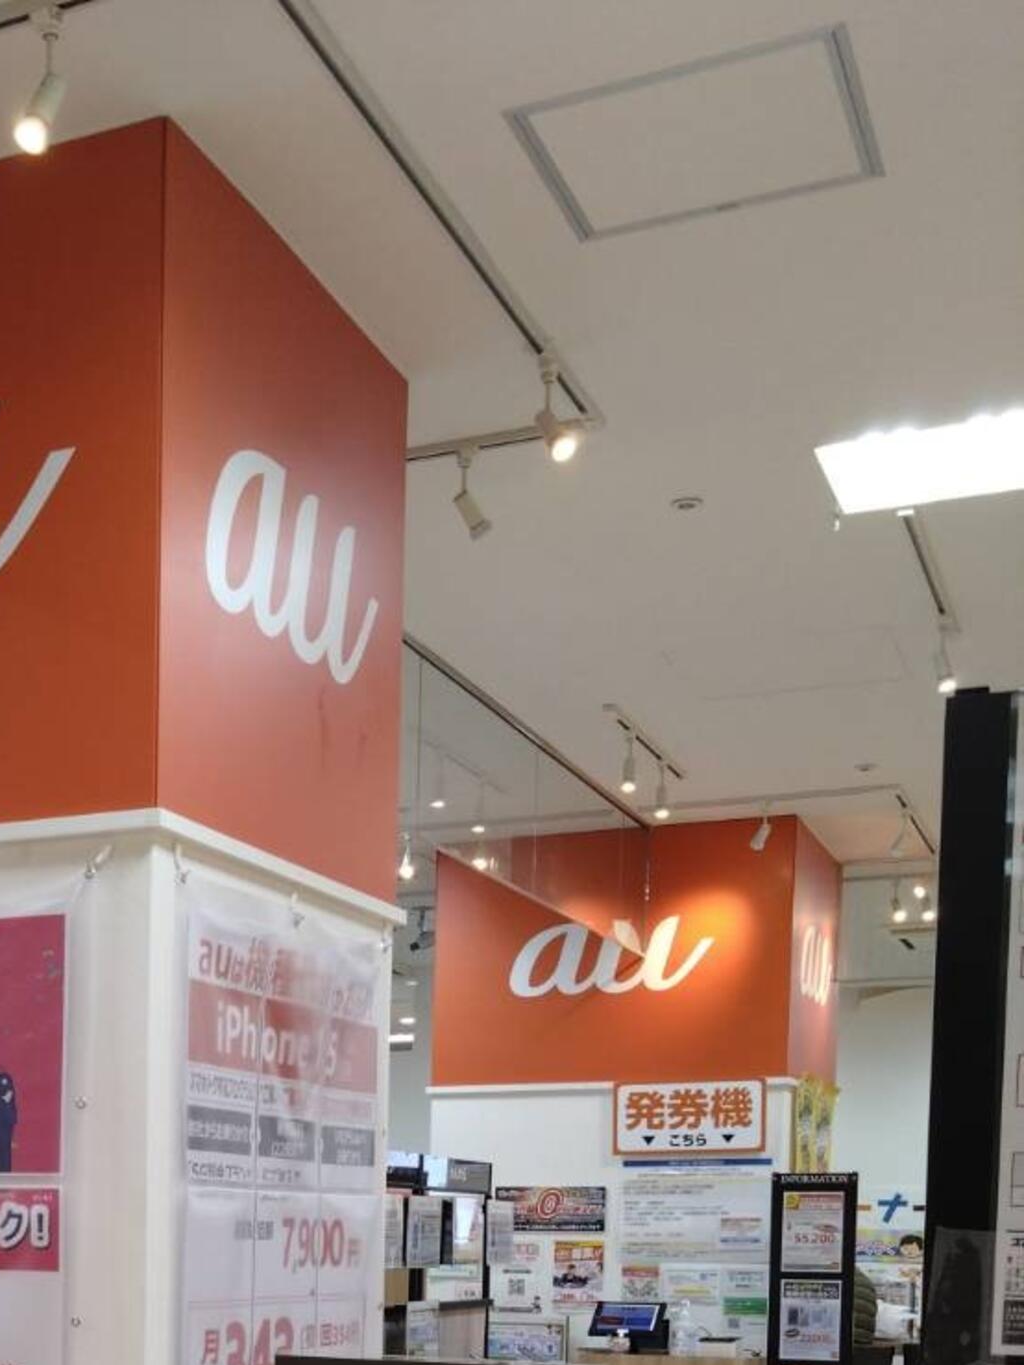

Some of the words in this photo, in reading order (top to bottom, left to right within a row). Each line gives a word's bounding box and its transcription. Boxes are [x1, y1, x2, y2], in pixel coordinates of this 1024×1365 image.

[205, 449, 378, 685] au
[509, 915, 714, 997] au
[625, 1088, 753, 1130] 発券機
[669, 1134, 707, 1147] こちら
